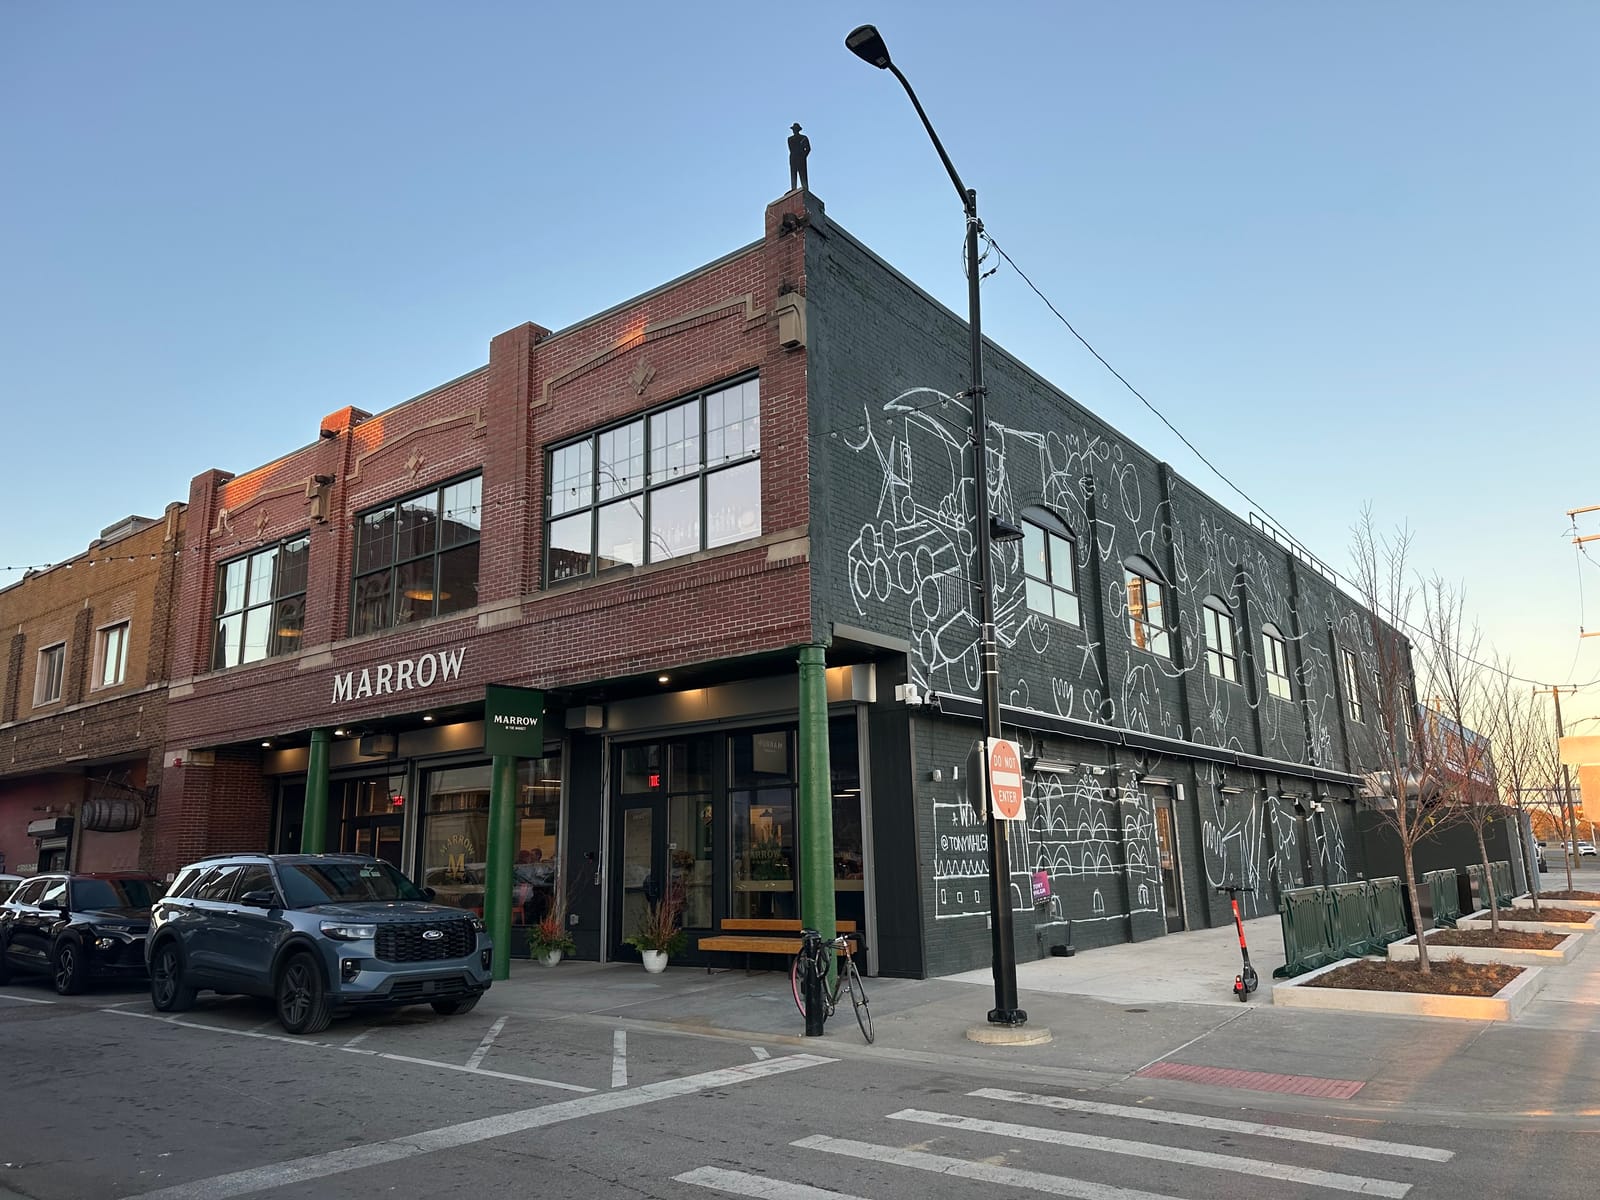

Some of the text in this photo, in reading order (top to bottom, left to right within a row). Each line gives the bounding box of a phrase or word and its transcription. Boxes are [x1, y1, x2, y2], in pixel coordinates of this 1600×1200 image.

[331, 647, 466, 704] MARROW
[493, 714, 538, 726] MARROW
[993, 755, 1017, 769] DO NOT
[999, 790, 1017, 804] ENTER
[440, 834, 475, 857] MARROW
